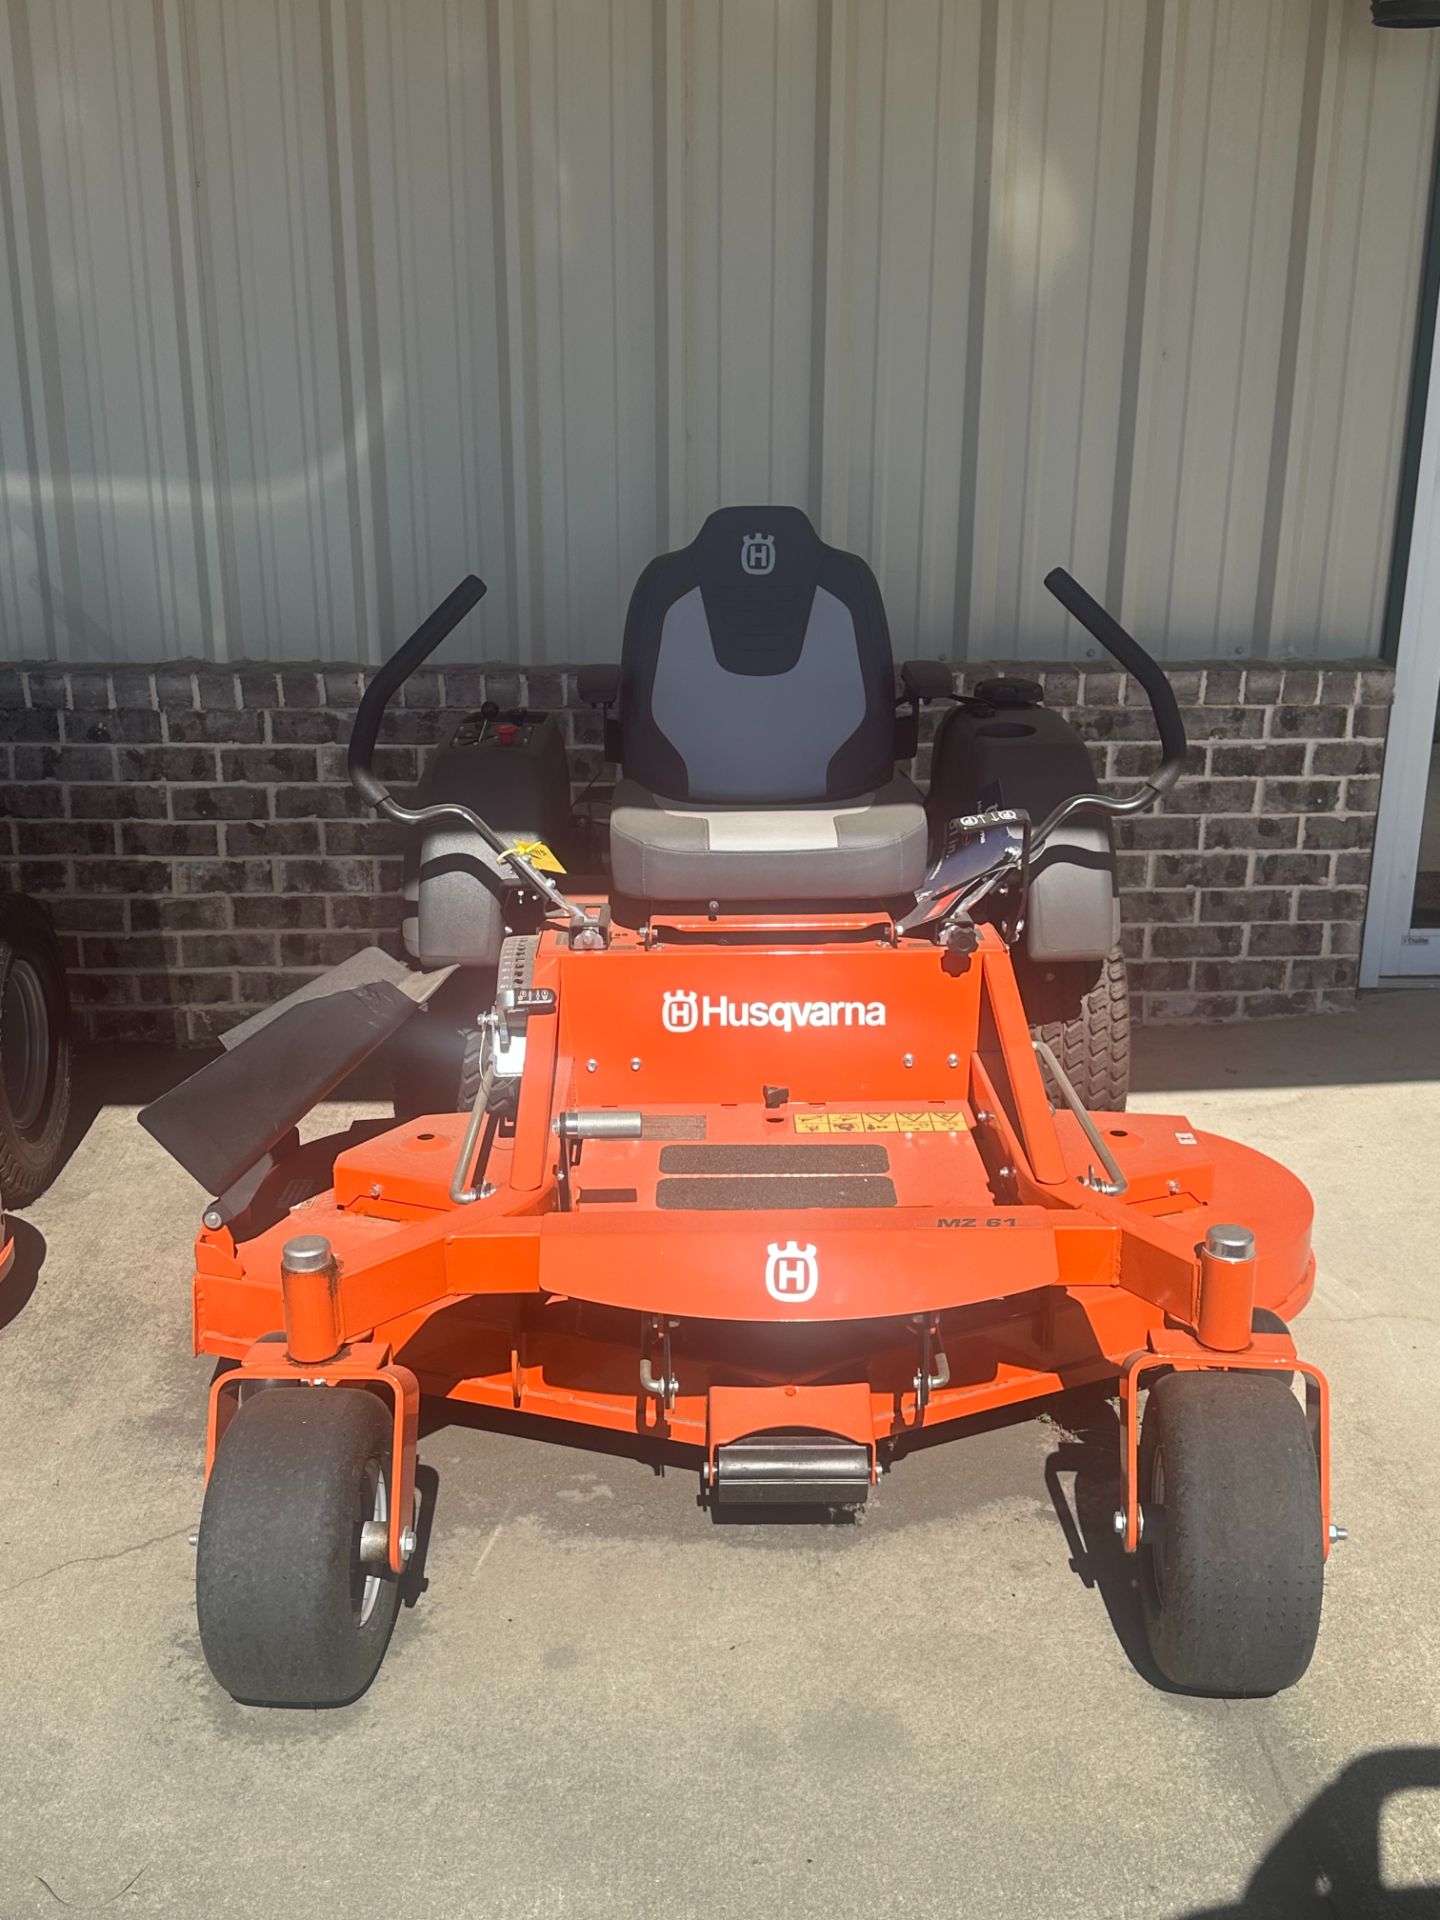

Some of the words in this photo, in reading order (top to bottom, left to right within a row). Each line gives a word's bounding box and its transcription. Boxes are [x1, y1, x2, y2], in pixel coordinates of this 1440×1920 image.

[749, 545, 767, 567] H
[703, 996, 886, 1032] Husqvarna
[937, 1218, 976, 1228] MZ
[986, 1218, 1016, 1227] 61
[778, 1260, 805, 1290] H
